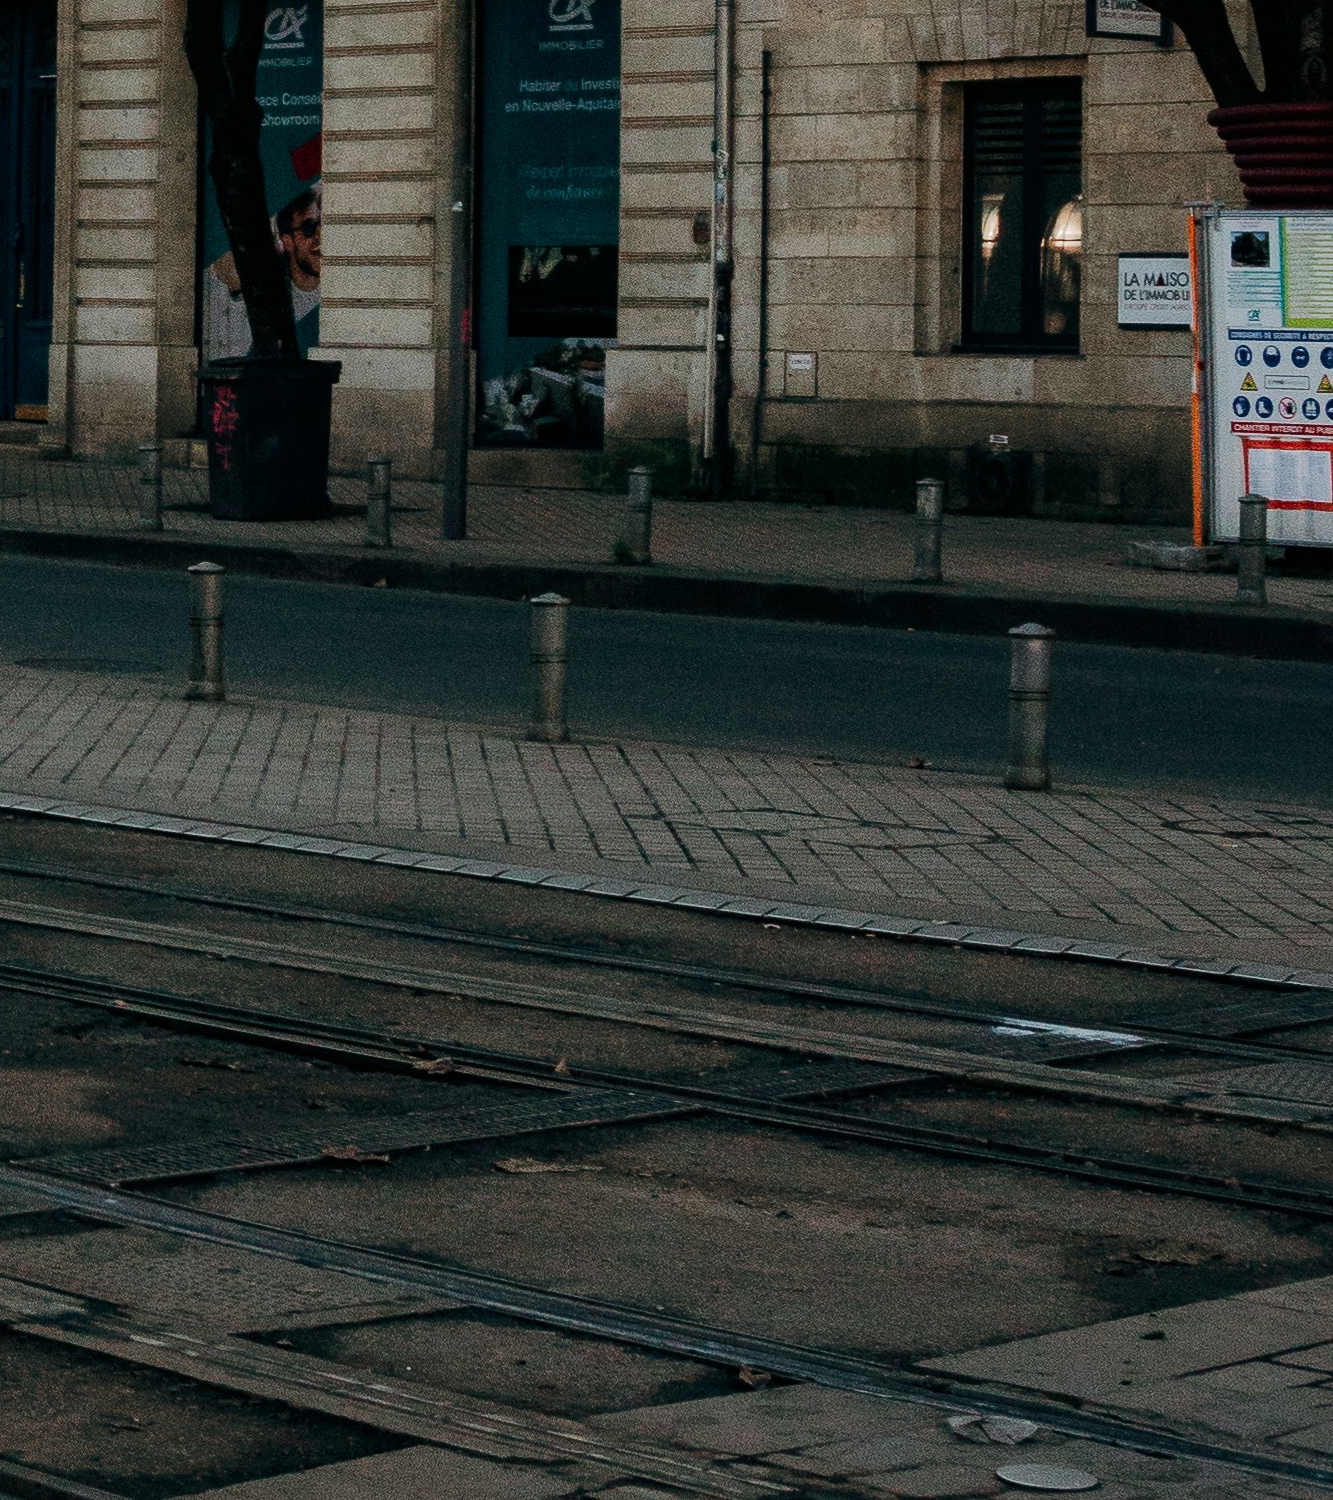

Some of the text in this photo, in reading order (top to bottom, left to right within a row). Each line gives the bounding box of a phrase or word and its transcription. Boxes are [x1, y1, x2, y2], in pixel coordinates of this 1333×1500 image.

[539, 39, 604, 51] IMMOBILIER
[519, 79, 562, 93] Habiter
[505, 101, 520, 113] en
[1124, 272, 1140, 287] LA
[1124, 289, 1137, 301] DE
[1233, 423, 1270, 432] CHANTIER
[1271, 424, 1303, 433] INTERDIT
[1304, 426, 1315, 434] AU
